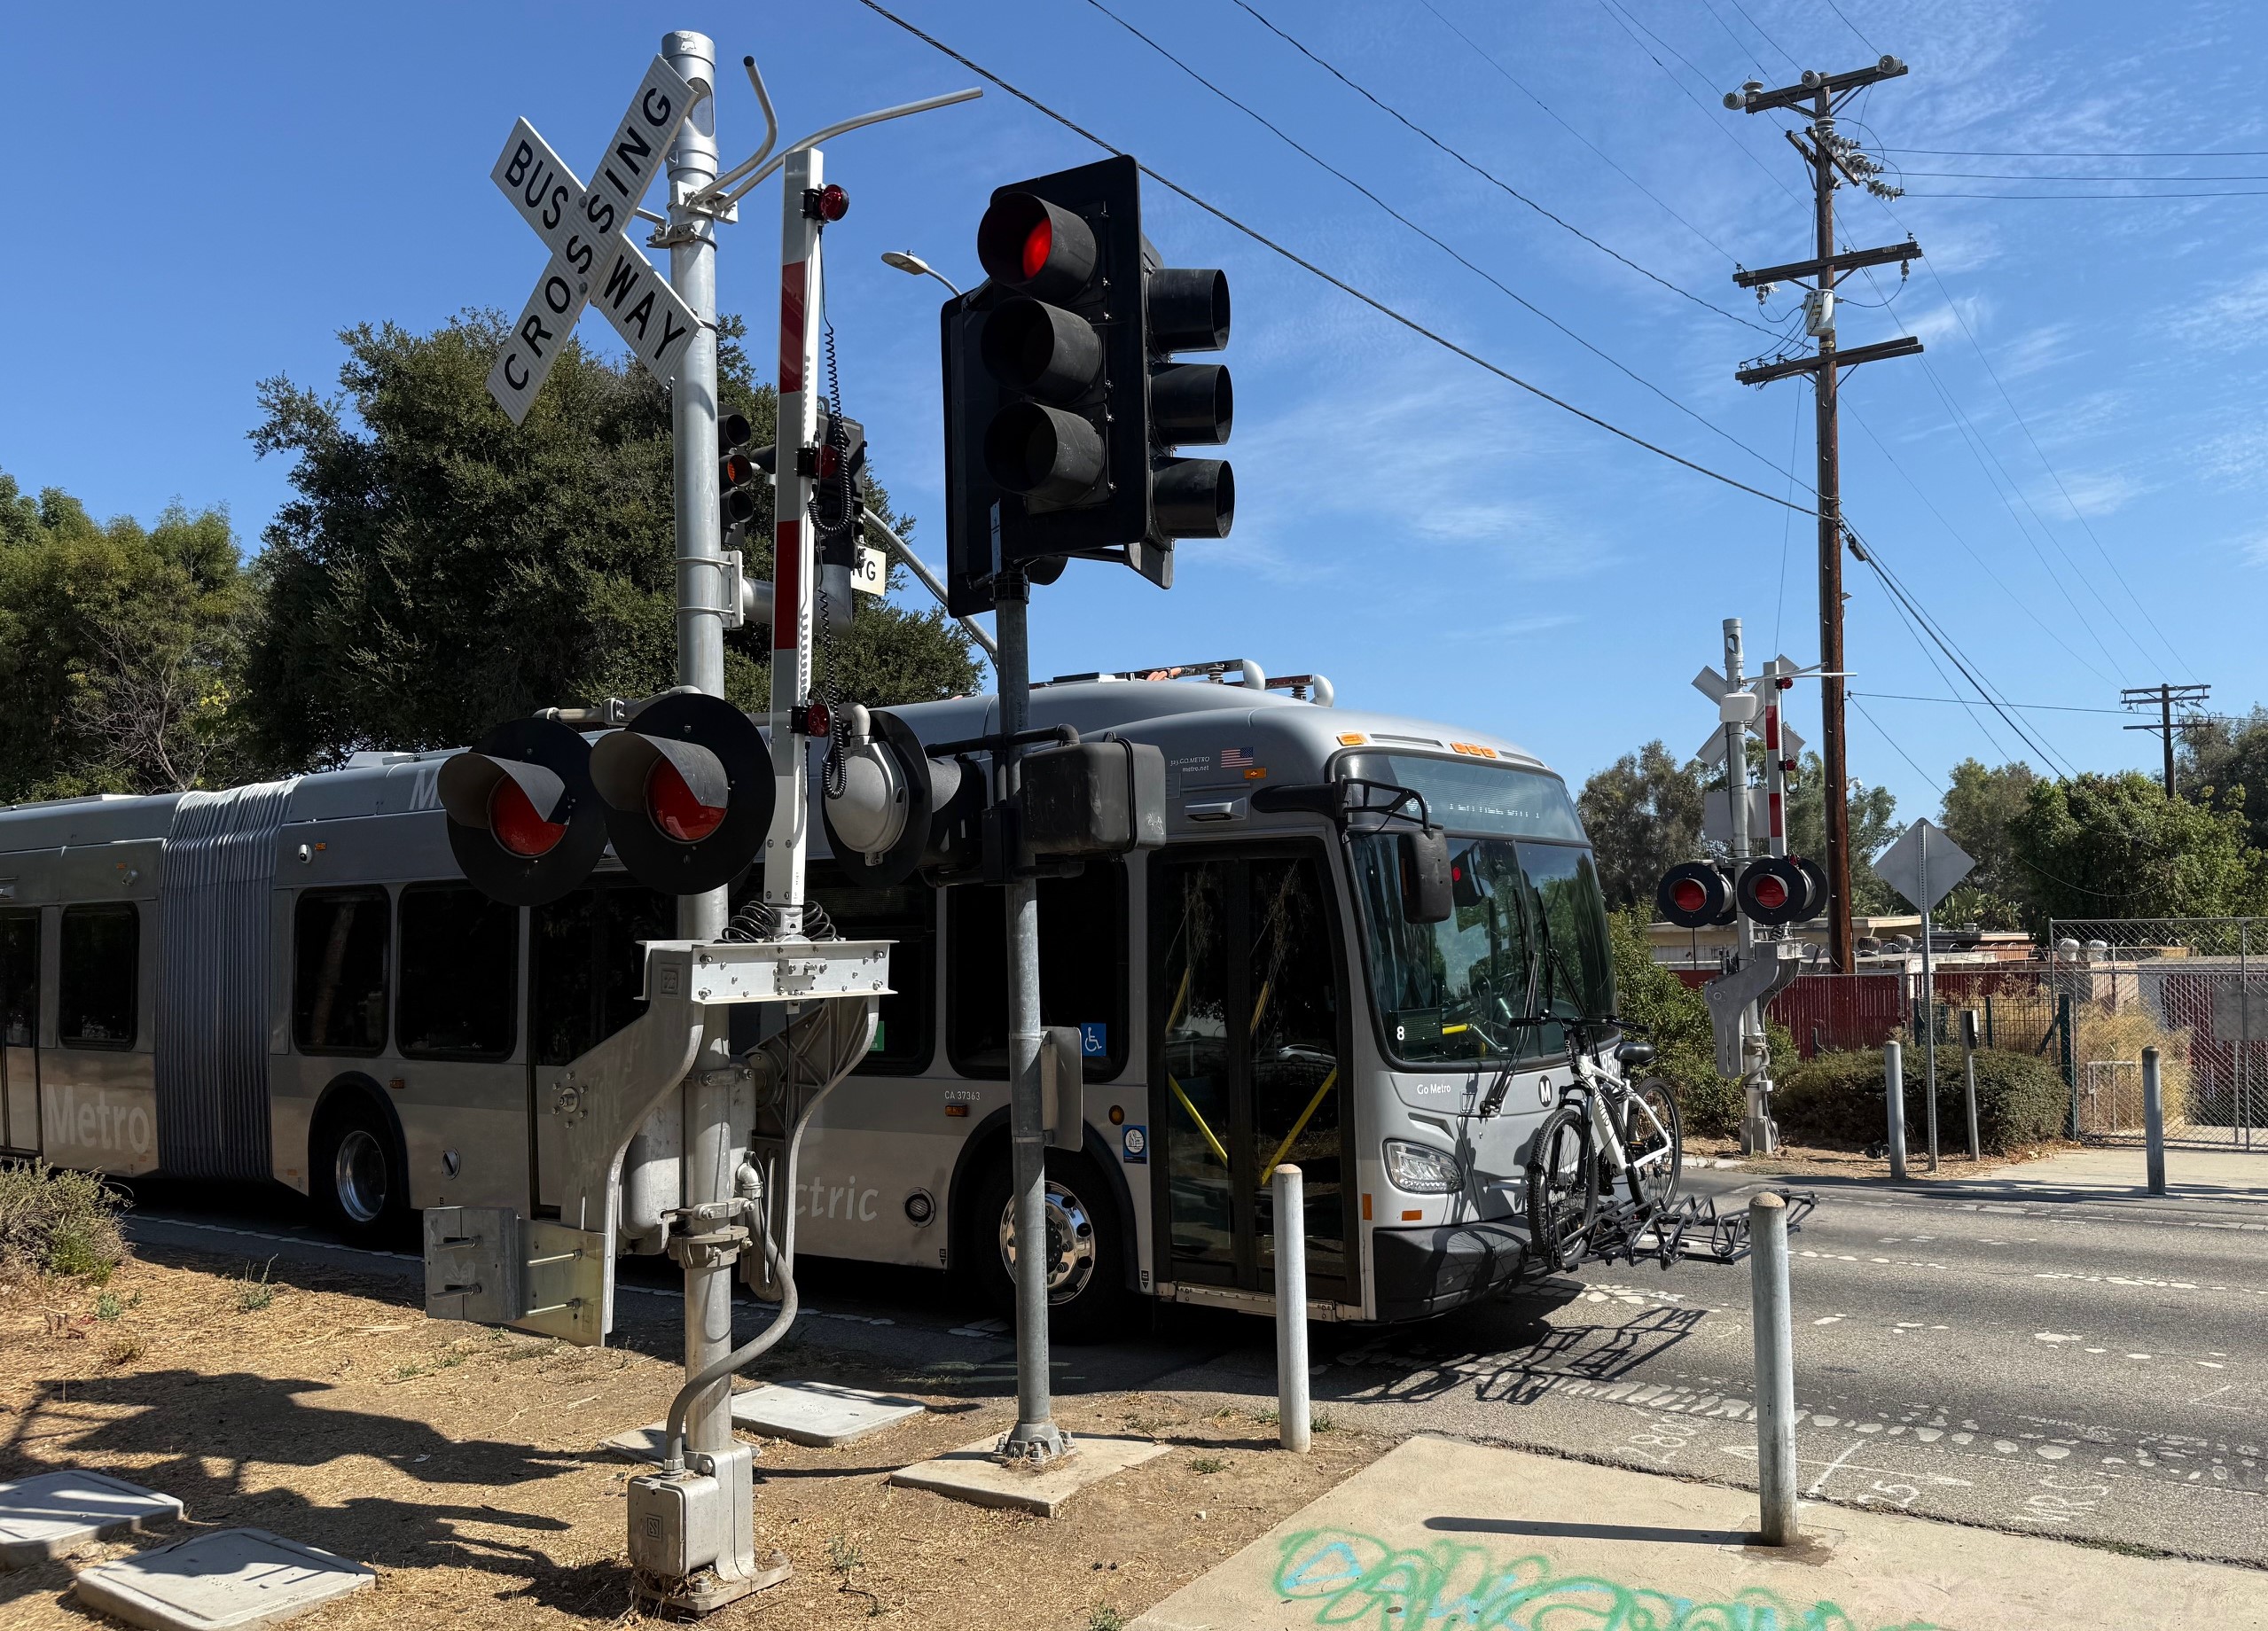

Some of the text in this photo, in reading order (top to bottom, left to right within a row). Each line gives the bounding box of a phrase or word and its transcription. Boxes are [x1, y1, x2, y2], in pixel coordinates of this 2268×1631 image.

[504, 87, 671, 391] CROSSING
[504, 139, 686, 360] BUS WAY
[1396, 1026, 1405, 1041] 8
[1601, 1050, 1621, 1075] 950
[944, 1090, 981, 1100] CA 37363
[1417, 1083, 1451, 1095] Go Metro
[46, 1083, 150, 1153] Metro
[795, 1175, 880, 1221] ctric
